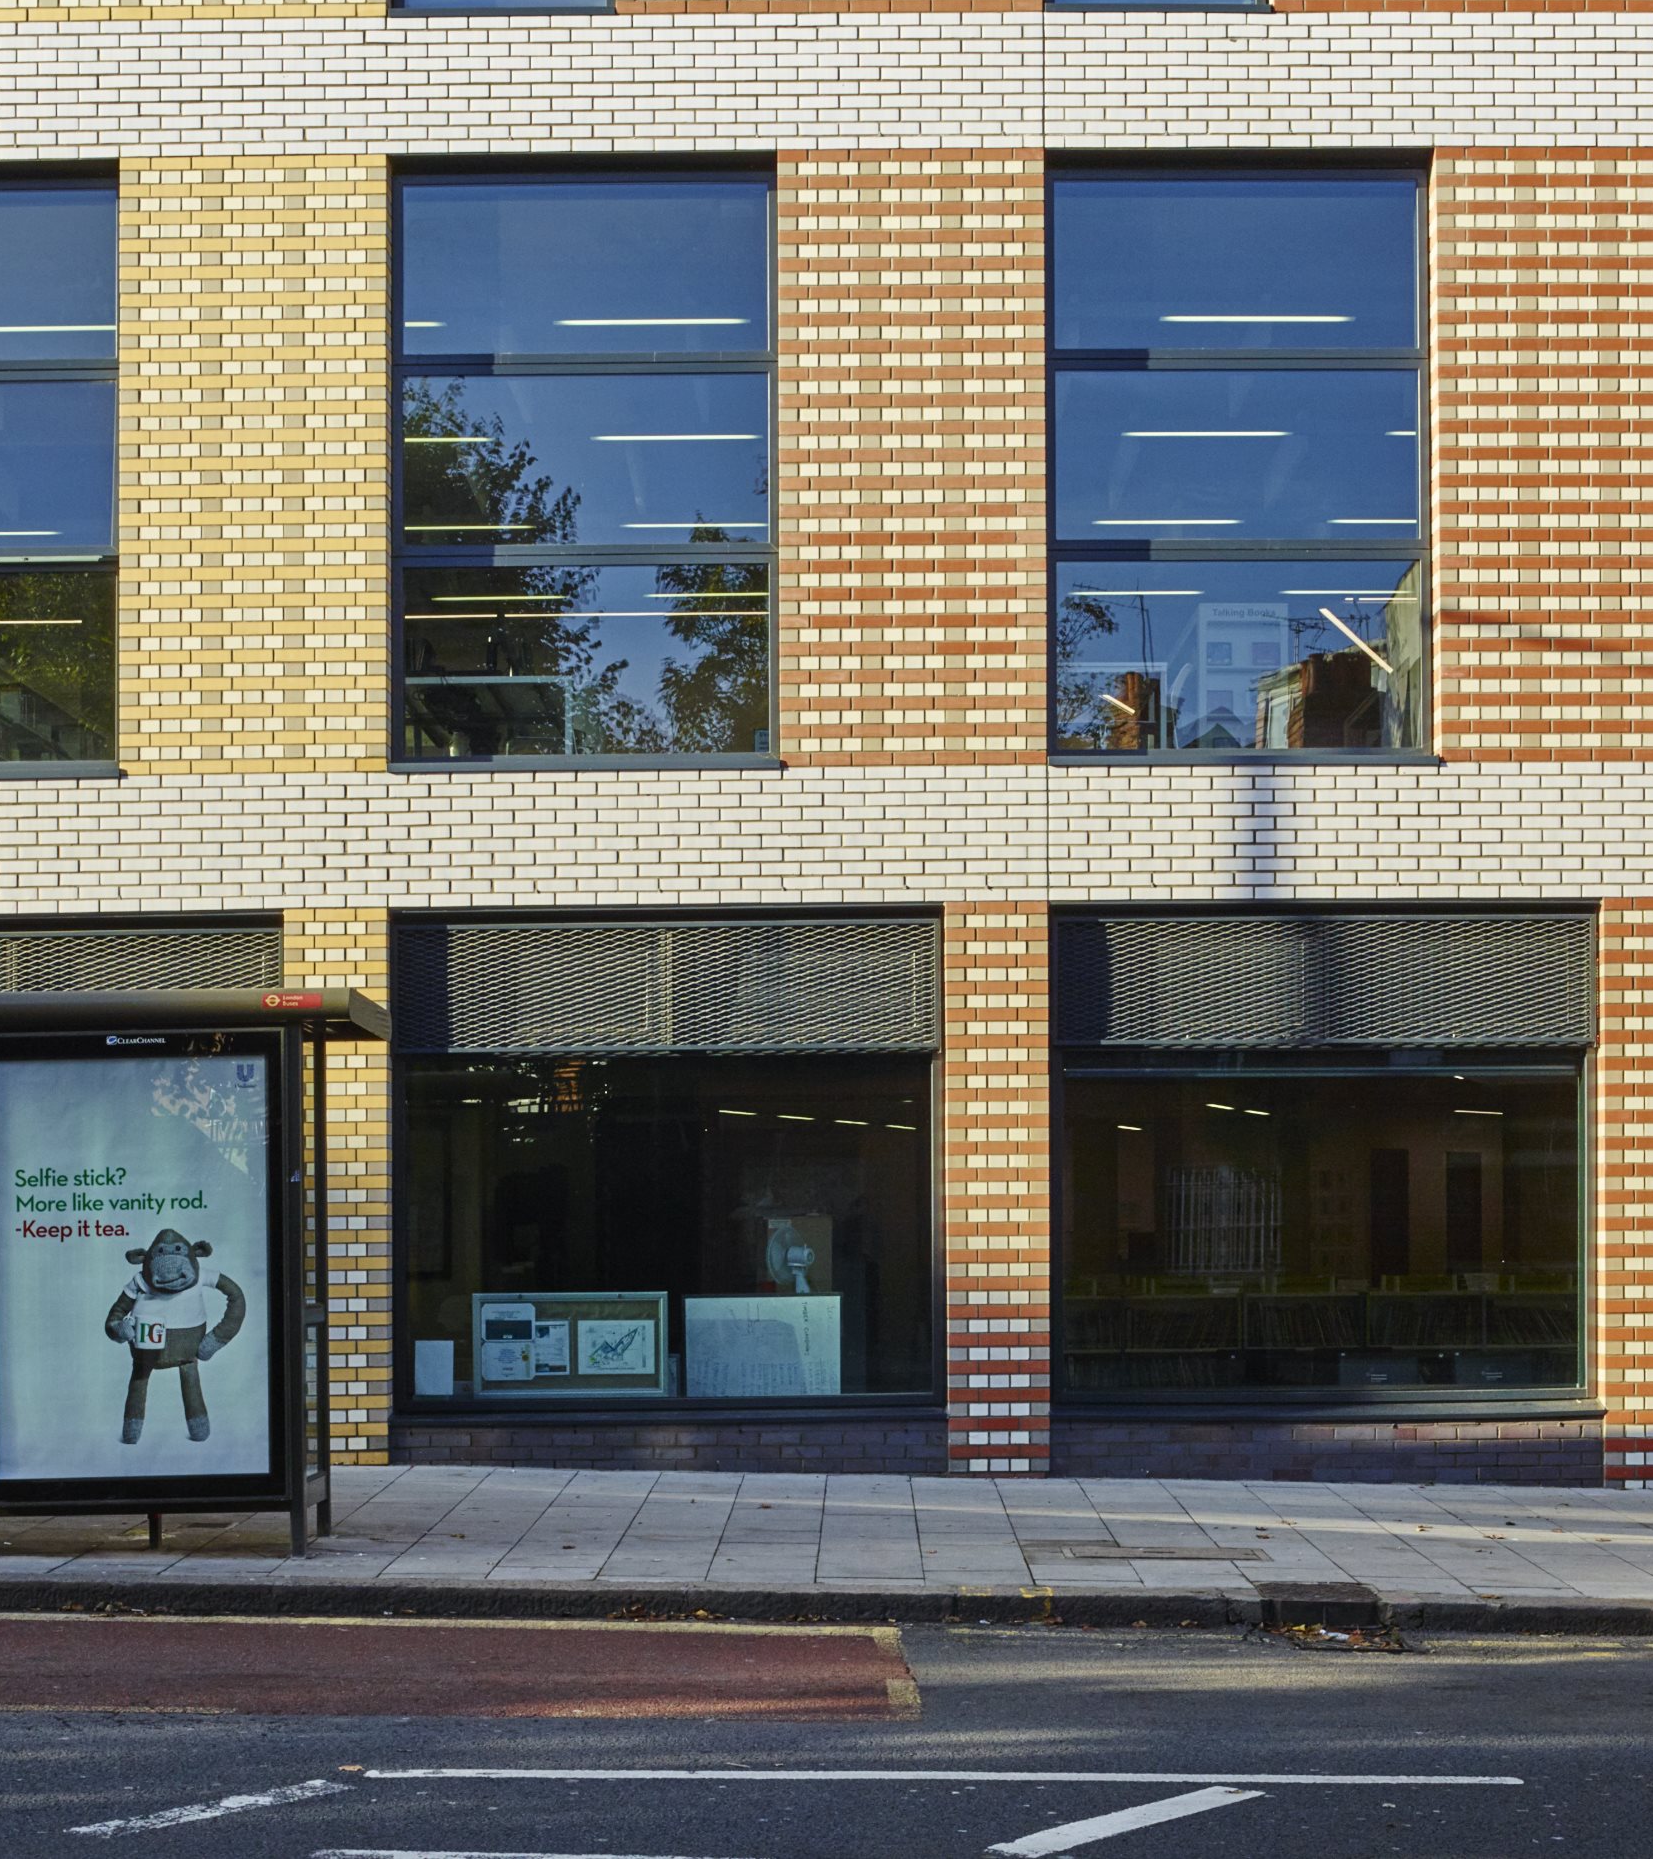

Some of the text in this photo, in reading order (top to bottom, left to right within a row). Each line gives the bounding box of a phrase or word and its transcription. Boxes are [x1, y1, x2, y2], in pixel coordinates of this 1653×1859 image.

[15, 1166, 127, 1188] Selfie stick?
[16, 1190, 208, 1215] More like vanity rod.
[15, 1219, 130, 1243] -Keep it tea.
[139, 1322, 163, 1343] PG
